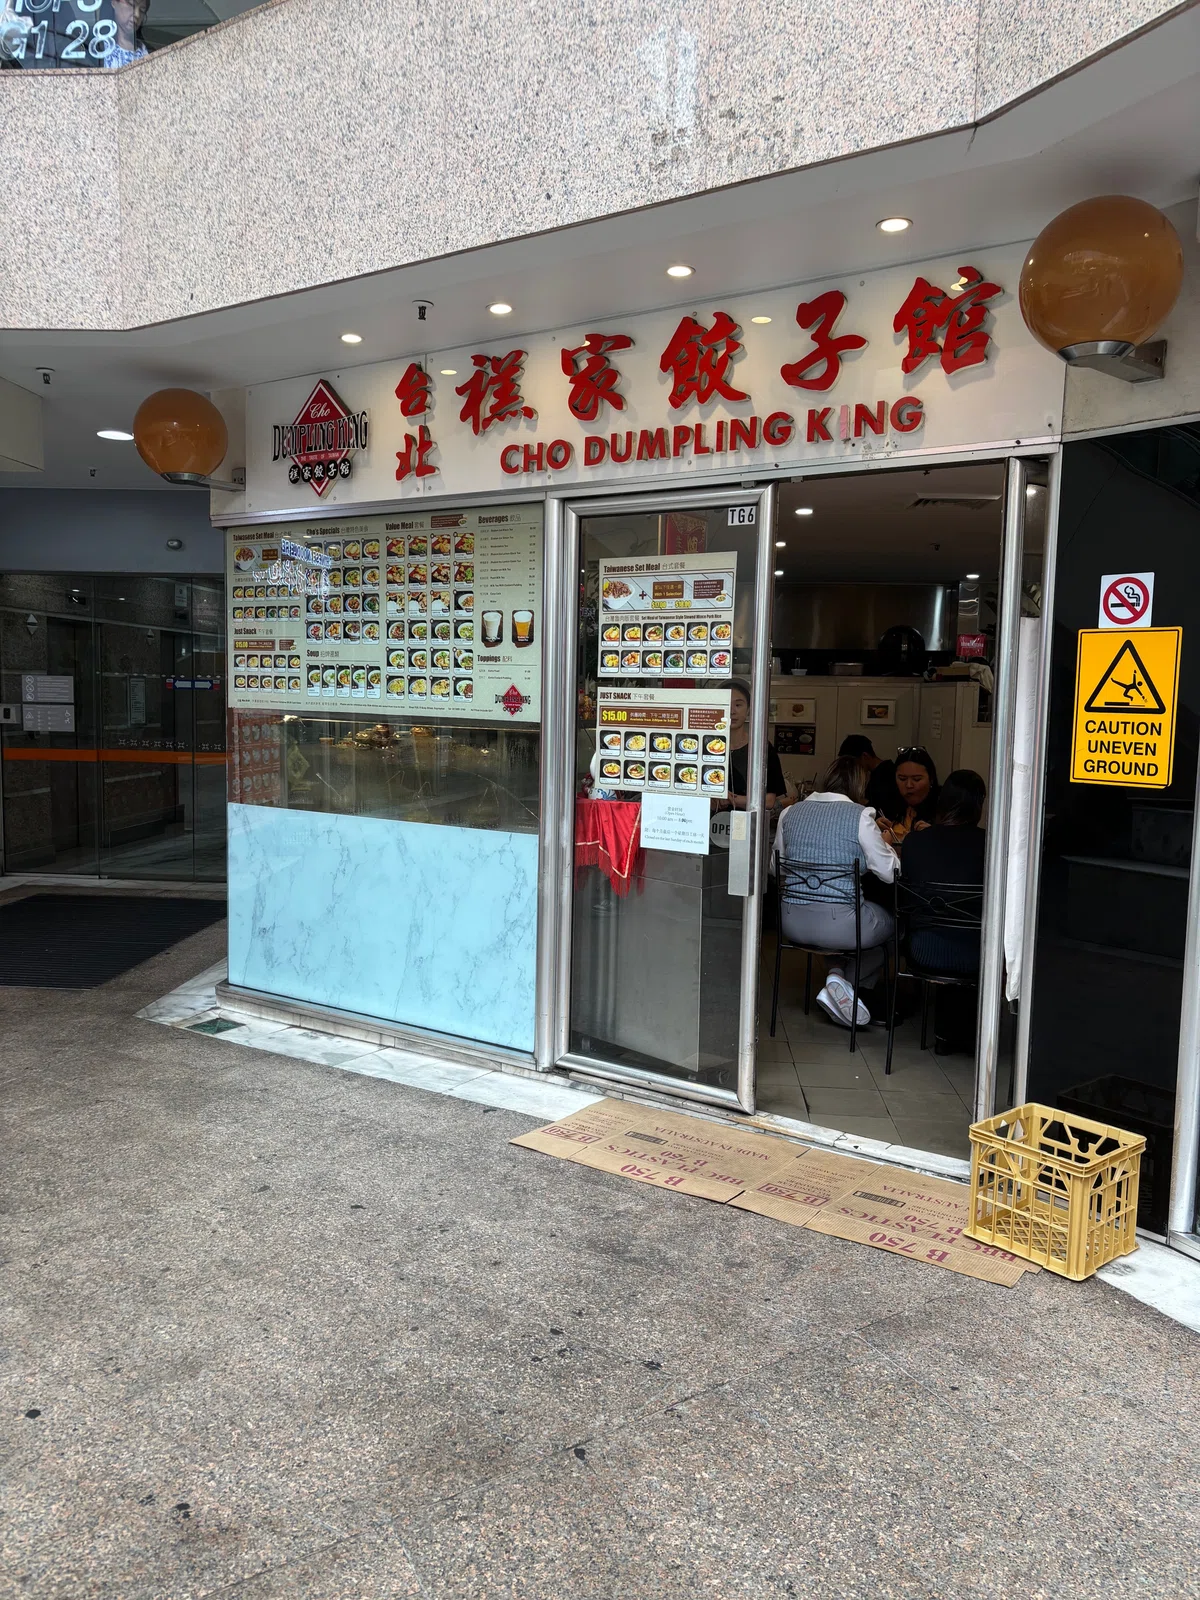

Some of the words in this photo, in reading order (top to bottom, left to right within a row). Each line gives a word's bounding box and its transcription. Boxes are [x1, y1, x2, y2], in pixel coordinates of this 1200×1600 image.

[61, 19, 117, 59] 28
[309, 402, 331, 419] Cho
[395, 363, 438, 482] 台北
[272, 420, 335, 461] DUMPLING
[337, 410, 368, 450] KING
[500, 440, 574, 475] CHO
[584, 412, 796, 467] DUMPLING
[806, 396, 925, 443] KING
[478, 515, 508, 524] Beverages
[729, 507, 754, 524] TG6
[320, 527, 340, 535] Specials
[385, 522, 399, 530] Value
[401, 521, 413, 529] Meal
[604, 565, 634, 573] Taiwanese
[306, 649, 320, 658] Soup
[477, 655, 501, 663] Toppings
[600, 692, 613, 700] JUST
[602, 711, 627, 722] $15.00
[1085, 720, 1162, 736] CAUTION
[1087, 740, 1157, 756] UNEVEN
[1083, 759, 1159, 777] GROUND
[711, 822, 731, 836] OPE
[549, 1127, 577, 1138] 750
[654, 1126, 714, 1147] AUSTRALIA
[604, 1144, 699, 1172] PLASTICS
[660, 1150, 690, 1161] 750
[734, 1146, 770, 1161] MADE
[692, 1158, 710, 1168] B
[620, 1163, 662, 1181] 750
[664, 1174, 687, 1188] B
[764, 1186, 798, 1200] 750
[882, 1184, 961, 1210] AUSTRALIA
[840, 1207, 955, 1245] PLASTICS
[903, 1215, 938, 1230] 750
[869, 1232, 917, 1252] 750
[927, 1249, 951, 1263] B
